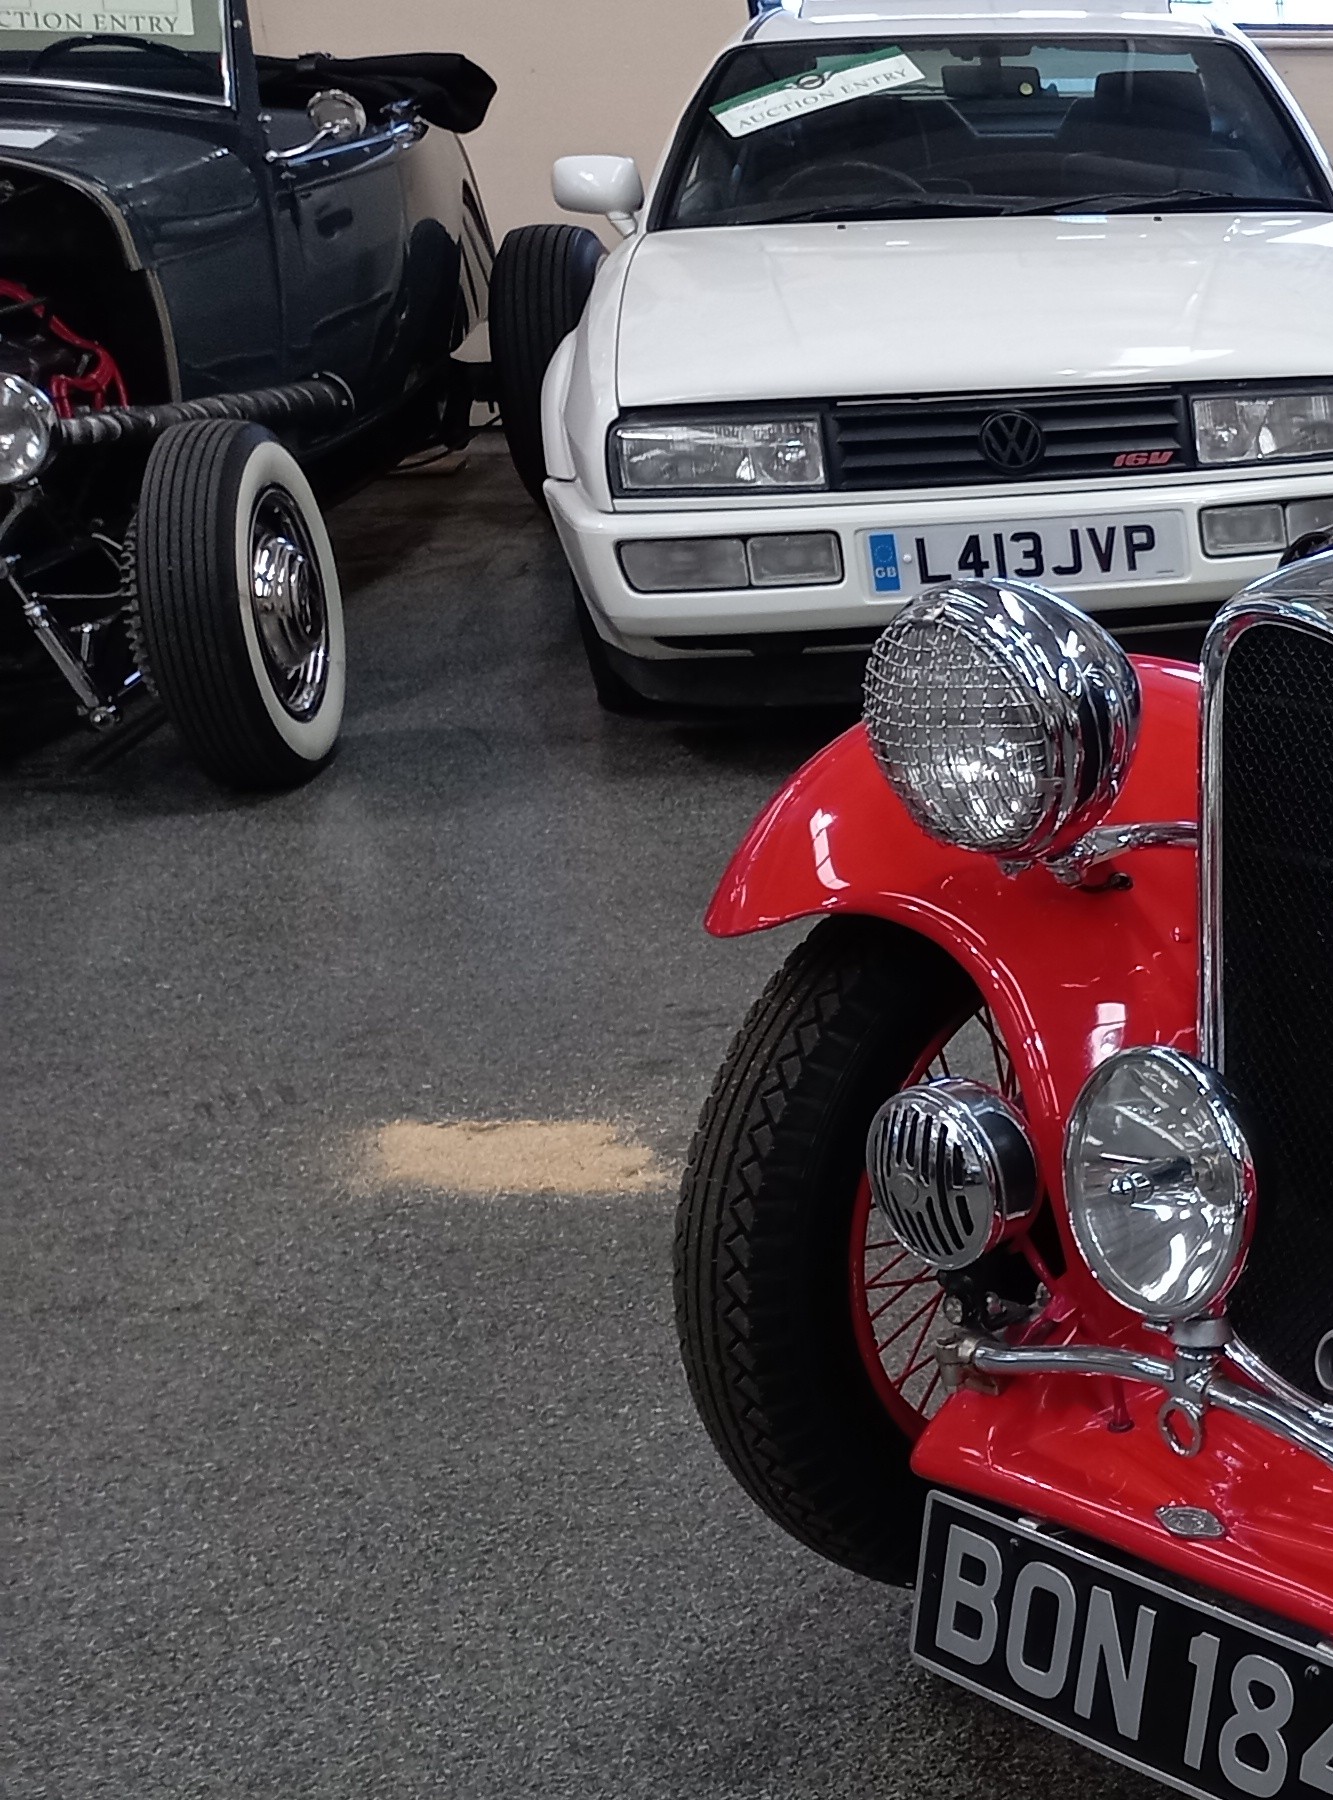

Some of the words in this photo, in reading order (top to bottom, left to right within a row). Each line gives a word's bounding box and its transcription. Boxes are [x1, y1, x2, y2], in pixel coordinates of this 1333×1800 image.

[93, 13, 178, 33] ENTRY
[738, 89, 835, 129] AUCTION
[840, 68, 908, 95] ENTRY
[1113, 450, 1174, 468] 16V
[875, 566, 897, 579] GB
[915, 529, 1045, 585] L413
[1051, 524, 1156, 578] JVP
[935, 1523, 1158, 1742] BON
